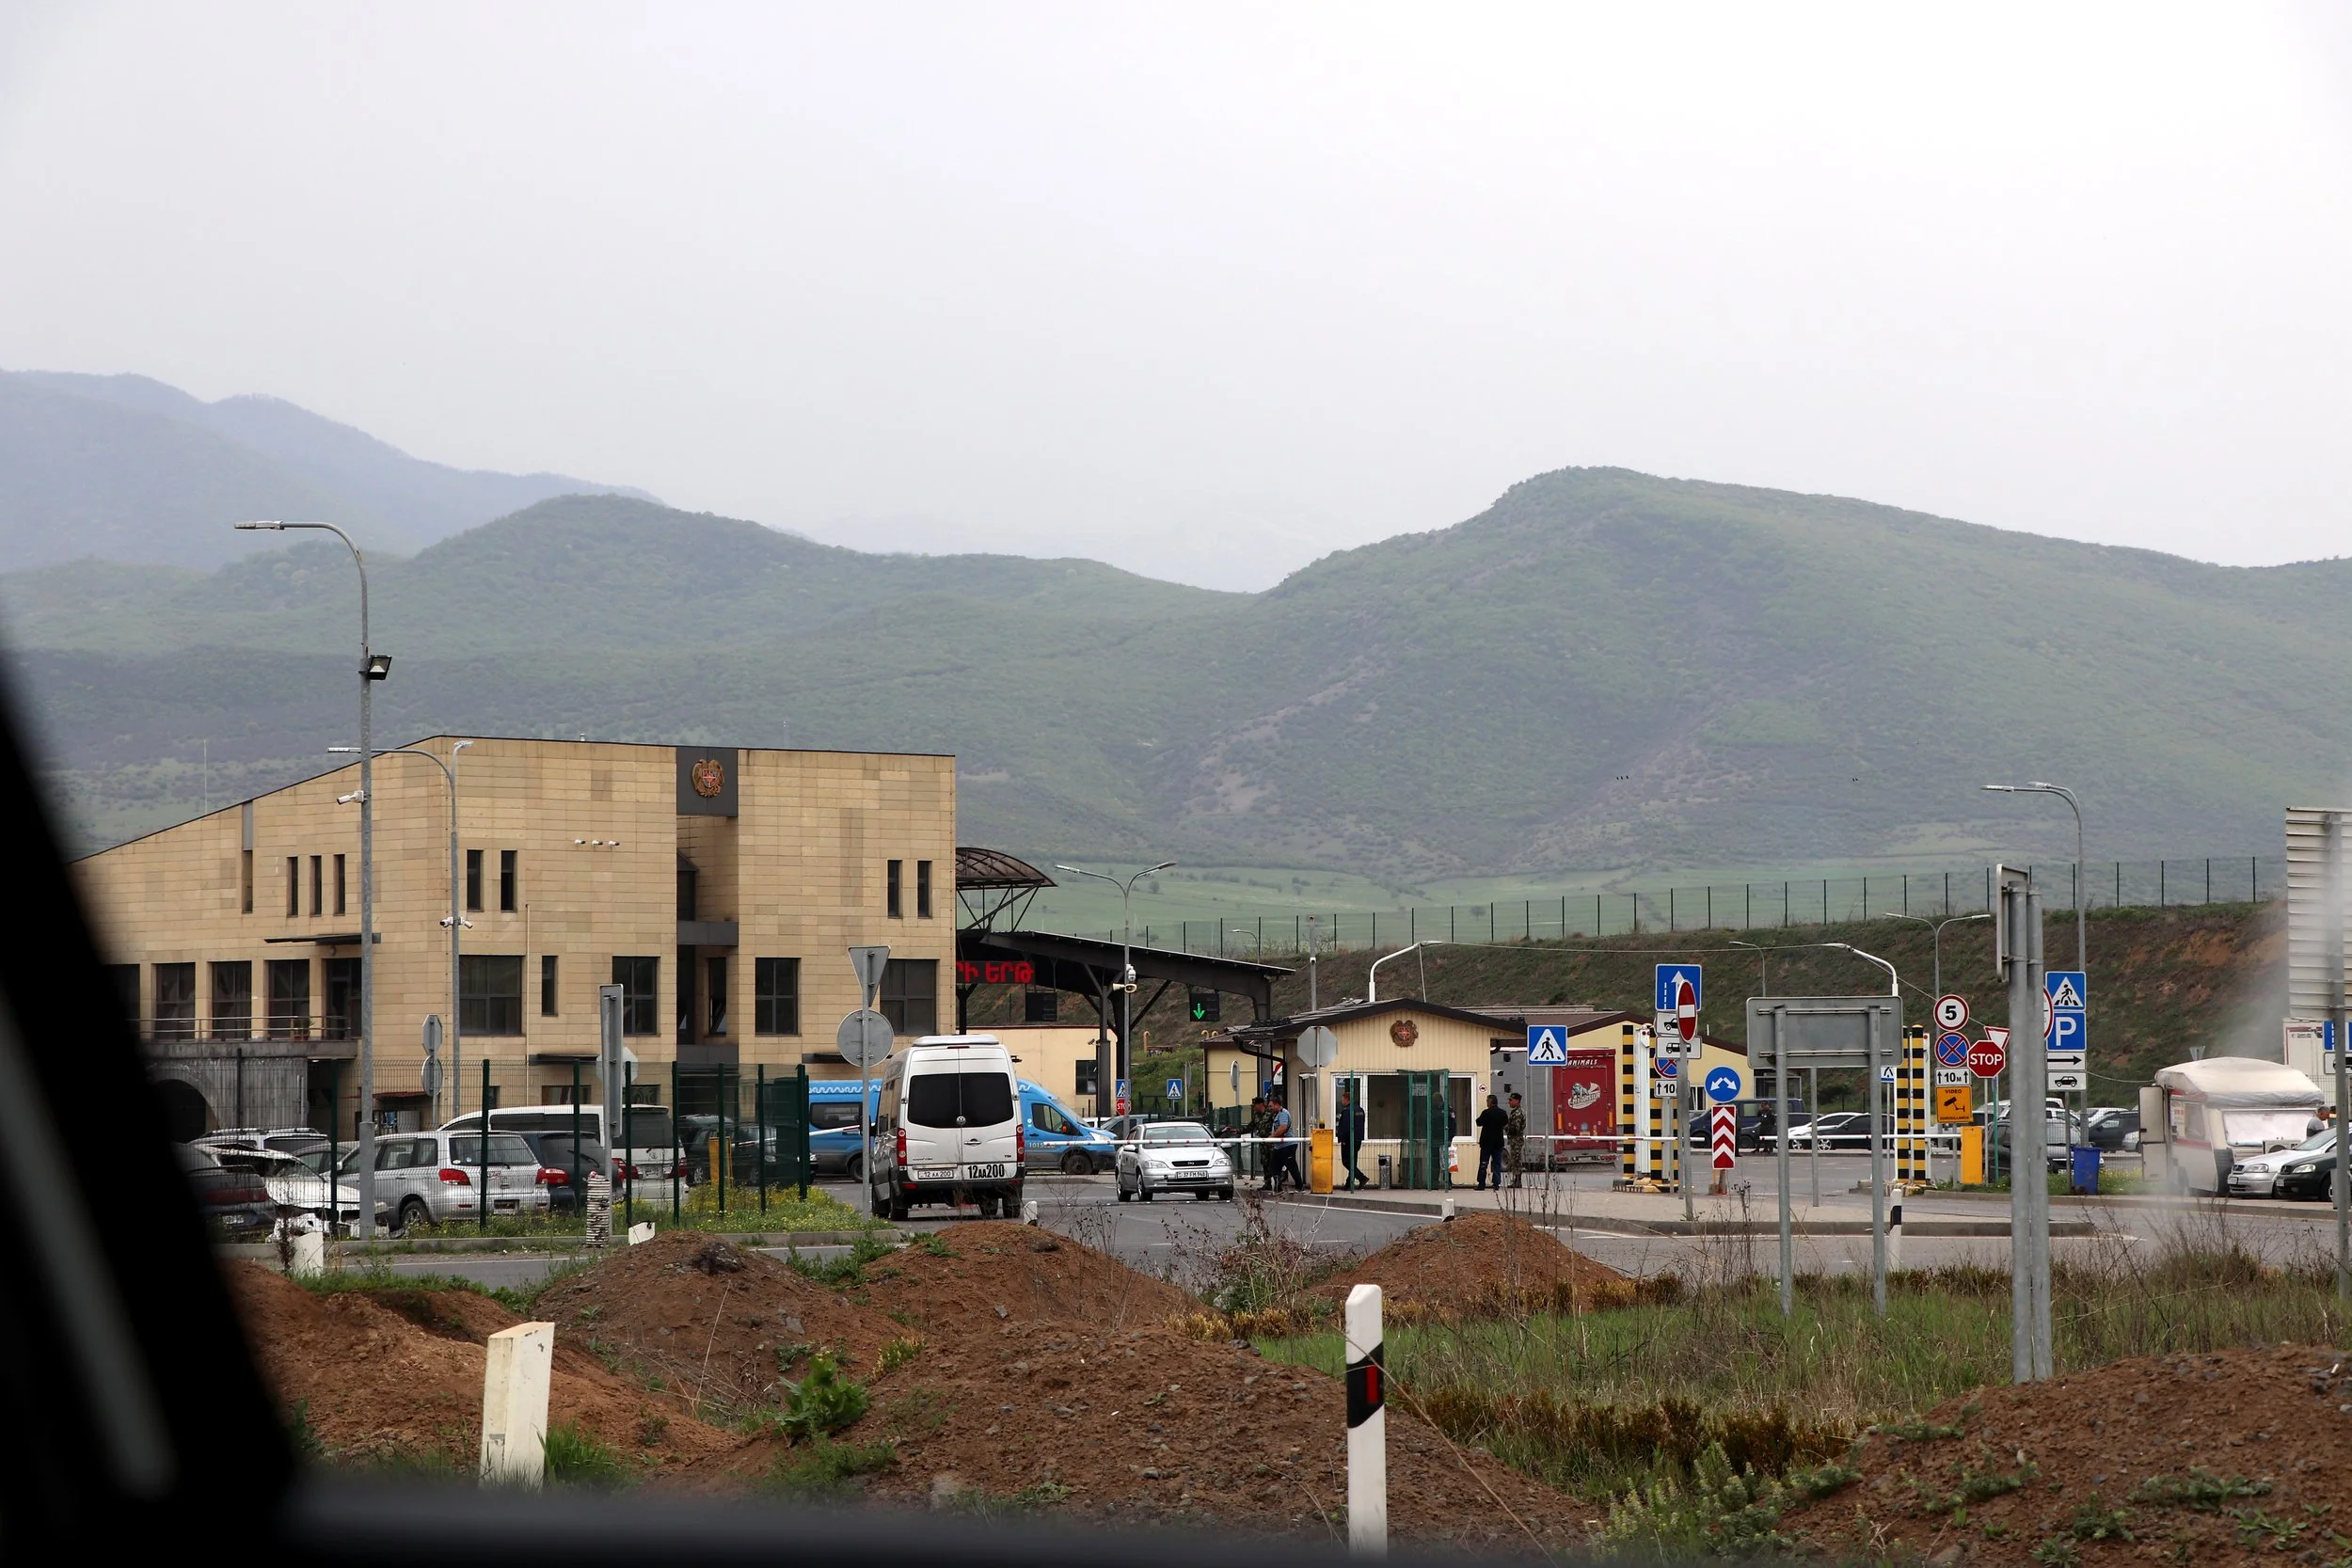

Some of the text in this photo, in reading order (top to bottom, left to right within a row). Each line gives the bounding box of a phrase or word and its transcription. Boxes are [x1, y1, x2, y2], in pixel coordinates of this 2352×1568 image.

[1945, 1005, 1958, 1021] 5
[2055, 1016, 2077, 1047] P
[1969, 1053, 2003, 1066] STOP
[1663, 1084, 1676, 1094] 10
